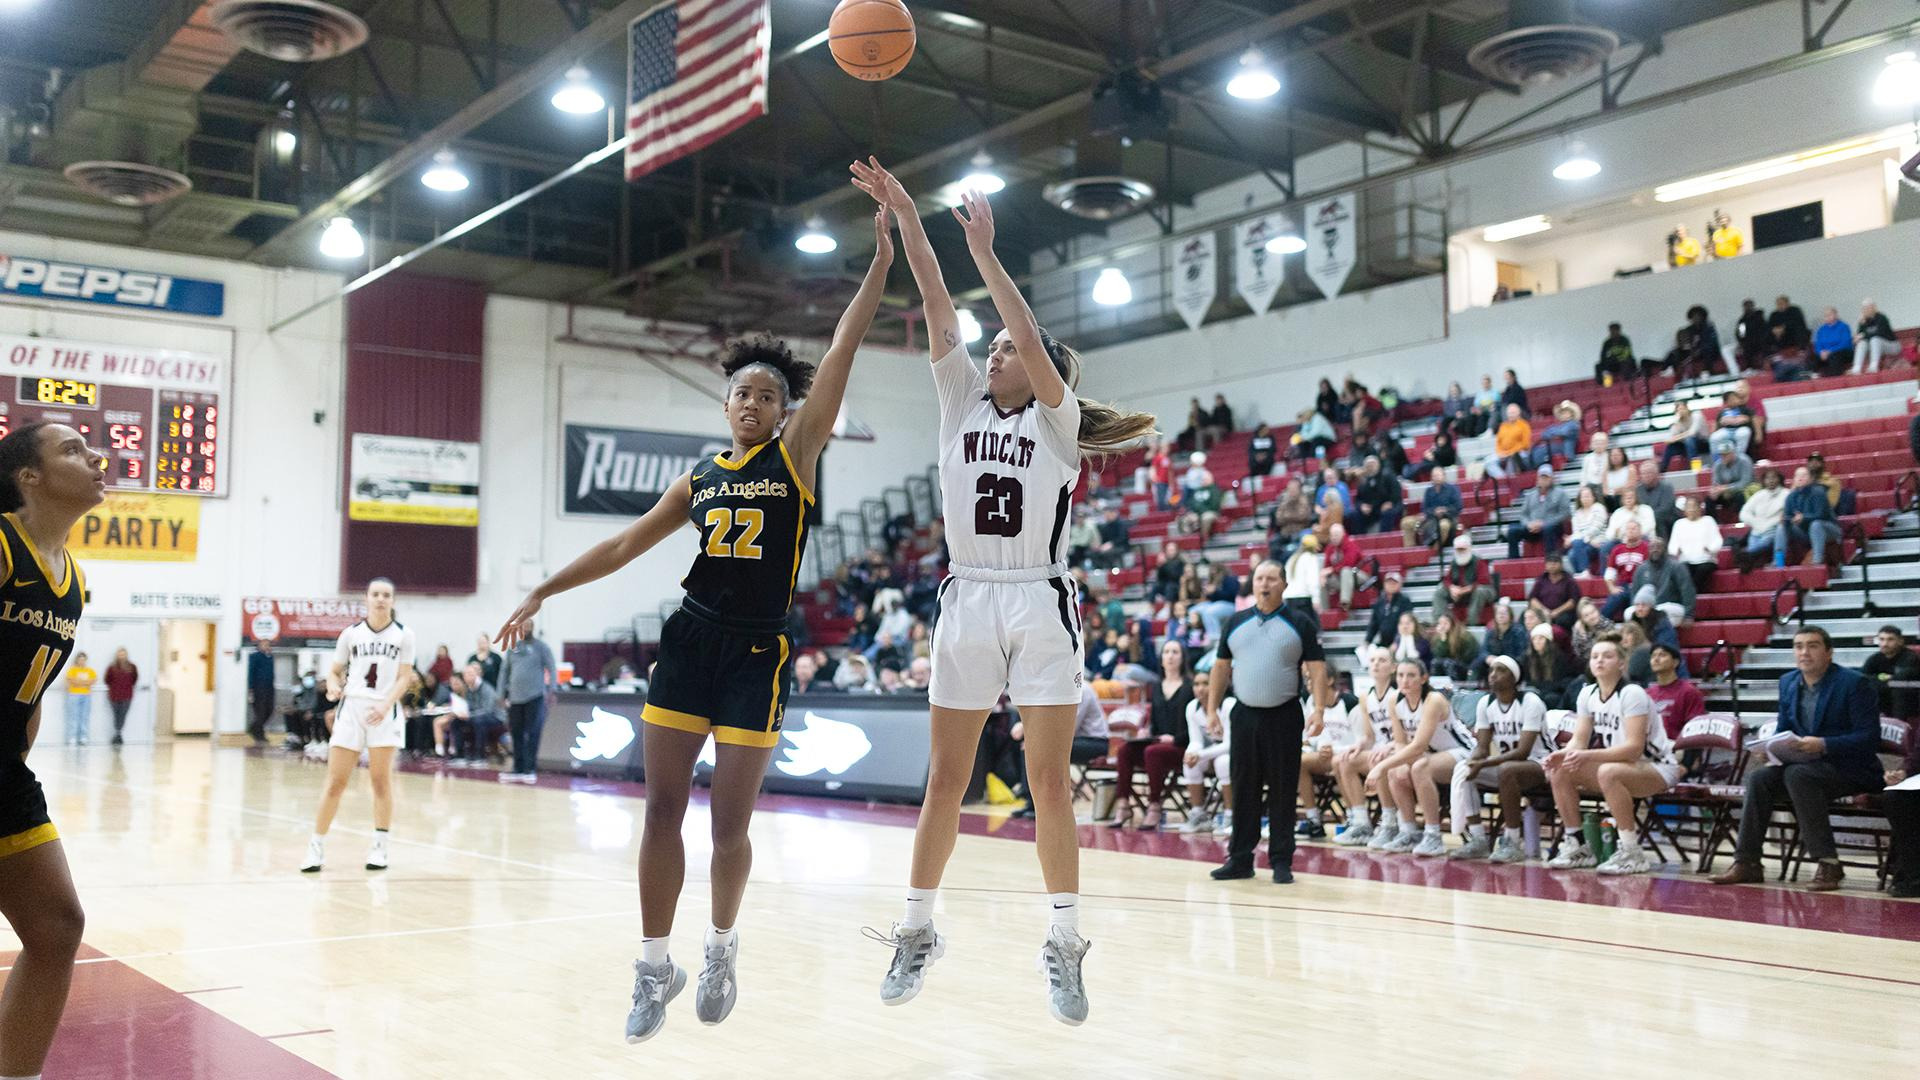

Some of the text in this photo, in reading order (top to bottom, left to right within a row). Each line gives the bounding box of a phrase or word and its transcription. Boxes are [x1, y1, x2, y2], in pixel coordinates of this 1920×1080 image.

[4, 259, 172, 308] PEPSI
[9, 345, 218, 382] OF THE WILDCATS!
[37, 377, 97, 406] 8:24
[109, 424, 143, 450] 52
[963, 430, 1036, 469] WIDCATS
[128, 458, 141, 479] 3
[716, 478, 788, 500] Angeles
[975, 472, 1023, 538] 23
[83, 514, 184, 548] PARTY
[705, 507, 765, 560] 22
[245, 599, 273, 615] GO
[352, 642, 400, 660] WILDCATS
[364, 663, 378, 688] 4
